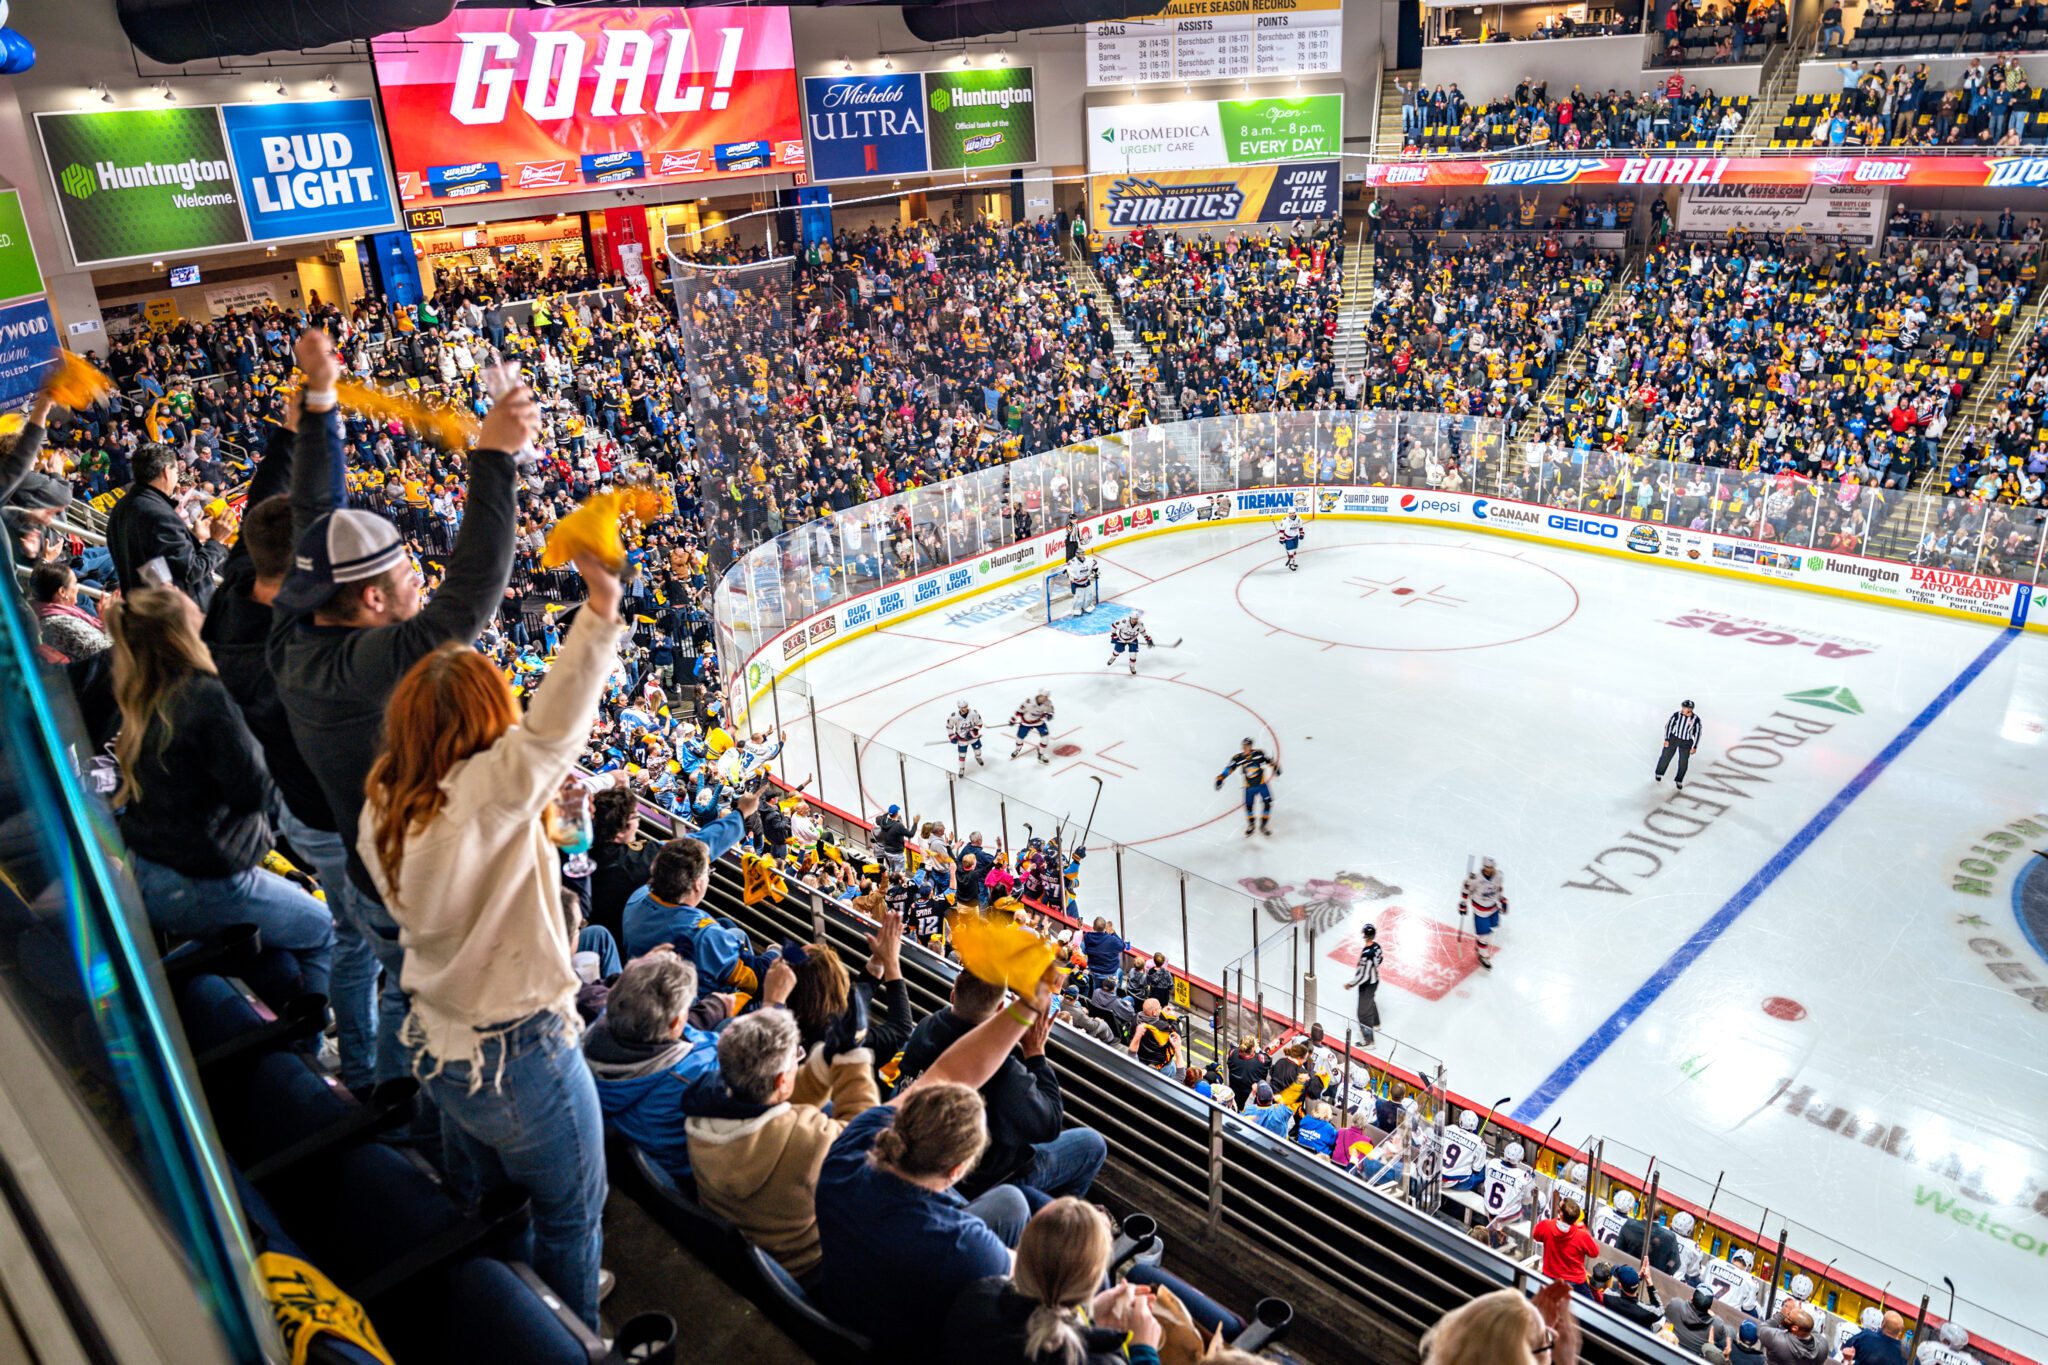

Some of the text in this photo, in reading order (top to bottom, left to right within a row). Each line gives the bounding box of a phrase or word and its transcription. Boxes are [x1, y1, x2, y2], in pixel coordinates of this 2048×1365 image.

[1210, 0, 1249, 12] SEASON
[1253, 0, 1296, 10] RECORDS
[1178, 21, 1213, 31] ASSISTS
[1258, 16, 1288, 27] POINTS
[1098, 25, 1125, 36] GOALS
[1099, 64, 1115, 72] Spink
[449, 28, 743, 125] GOAL!
[823, 84, 903, 108] Michelob
[952, 87, 1032, 109] Huntington
[1265, 106, 1301, 124] Open
[810, 107, 923, 140] ULTRA
[955, 119, 1009, 130] Official bank of the
[1240, 123, 1325, 136] 8 a.m. 8 p.m.
[261, 132, 352, 174] BUD
[1120, 142, 1194, 155] URGENT CARE
[1240, 137, 1324, 155] EVERY DAY
[96, 158, 230, 192] Huntington
[1284, 170, 1327, 185] JOIN
[1386, 166, 1429, 183] GOAL!
[1617, 157, 1730, 184] GOAL!
[1854, 161, 1911, 181] GOAL!
[252, 168, 374, 213] LIGHT
[1166, 185, 1230, 195] TOLEDO WALLEYE
[1291, 186, 1326, 199] THE
[172, 192, 236, 209] Welcome.
[1114, 191, 1240, 223] FINATICS
[1280, 200, 1326, 215] CLUB
[412, 210, 442, 226] 19:39
[1693, 206, 1708, 216] Just
[1710, 205, 1730, 216] What
[1754, 206, 1781, 219] Looking
[432, 241, 454, 252] PIZZA
[494, 233, 526, 244] BURGERS
[1, 365, 29, 378] TOLEDO
[1237, 493, 1294, 510] TIREMAN
[1344, 494, 1389, 504] SWAMP SHOP
[1421, 500, 1460, 514] pepsi
[1490, 506, 1539, 524] CANAAN
[1490, 517, 1523, 526] COMPANIES
[1548, 515, 1618, 538] GEICO
[990, 546, 1034, 569] Huntington
[950, 569, 968, 582] BUD
[1826, 558, 1899, 583] Huntington
[918, 579, 938, 593] BUD
[946, 577, 972, 591] LIGHT
[1910, 567, 2013, 596] BAUMANN
[880, 592, 900, 606] BUD
[915, 587, 941, 602] LIGHT
[1905, 587, 2009, 611] Oregon Fremont Genoa
[1920, 582, 1999, 601] AUTO GROUP
[847, 603, 867, 618] BUD
[877, 599, 904, 616] LIGHT
[1690, 608, 1731, 619] CAN
[1912, 595, 2002, 617] Tiffin Port Clinton
[845, 612, 871, 629] LIGHT
[1736, 617, 1767, 627] WE
[1665, 615, 1874, 659] A-GAS
[918, 915, 938, 936] 12
[1488, 1181, 1506, 1209] 6
[1604, 1218, 1622, 1232] BRIC
[1712, 1277, 1731, 1300] 7
